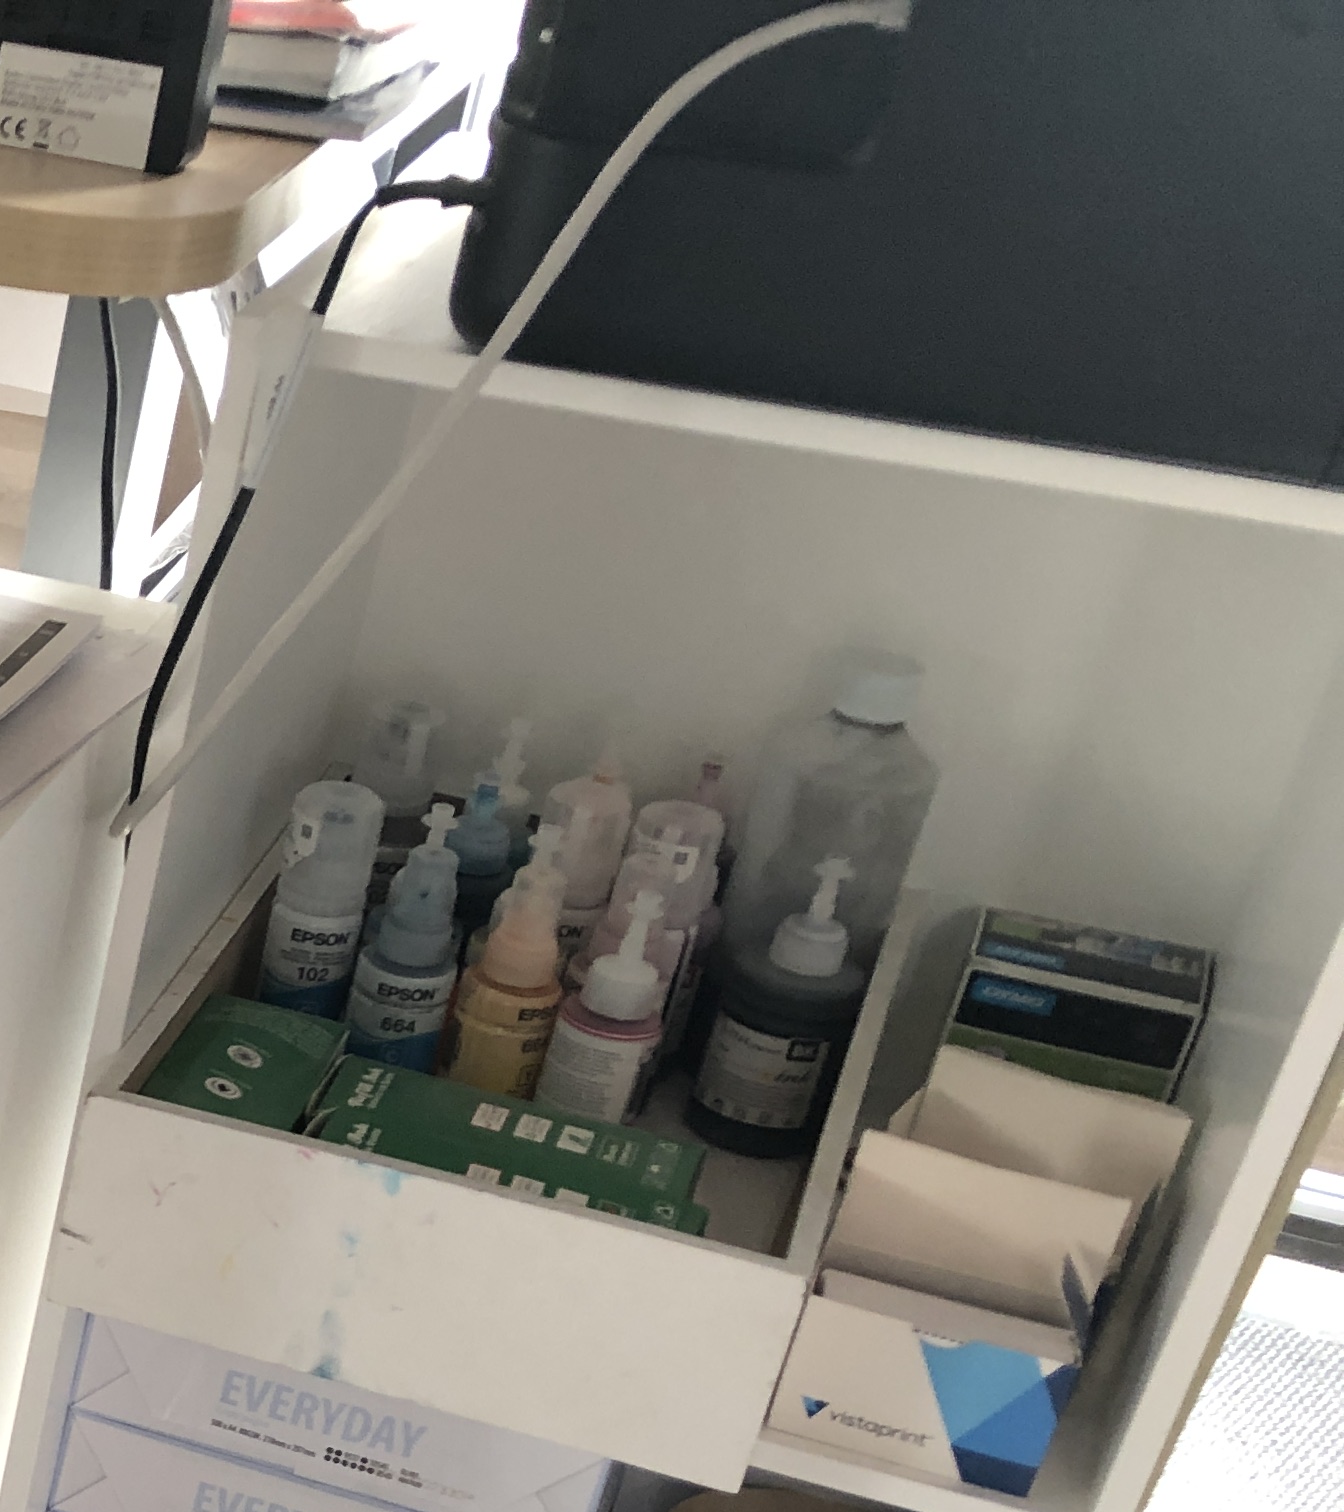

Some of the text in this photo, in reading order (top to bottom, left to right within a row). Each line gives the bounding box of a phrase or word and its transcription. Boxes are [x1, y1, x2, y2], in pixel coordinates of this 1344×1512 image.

[290, 927, 350, 946] EPSON
[296, 966, 330, 983] 102
[377, 981, 437, 1001] EPSON
[379, 1016, 417, 1033] 664
[219, 1370, 428, 1458] EVERYDAY
[829, 1410, 932, 1447] vistaprint
